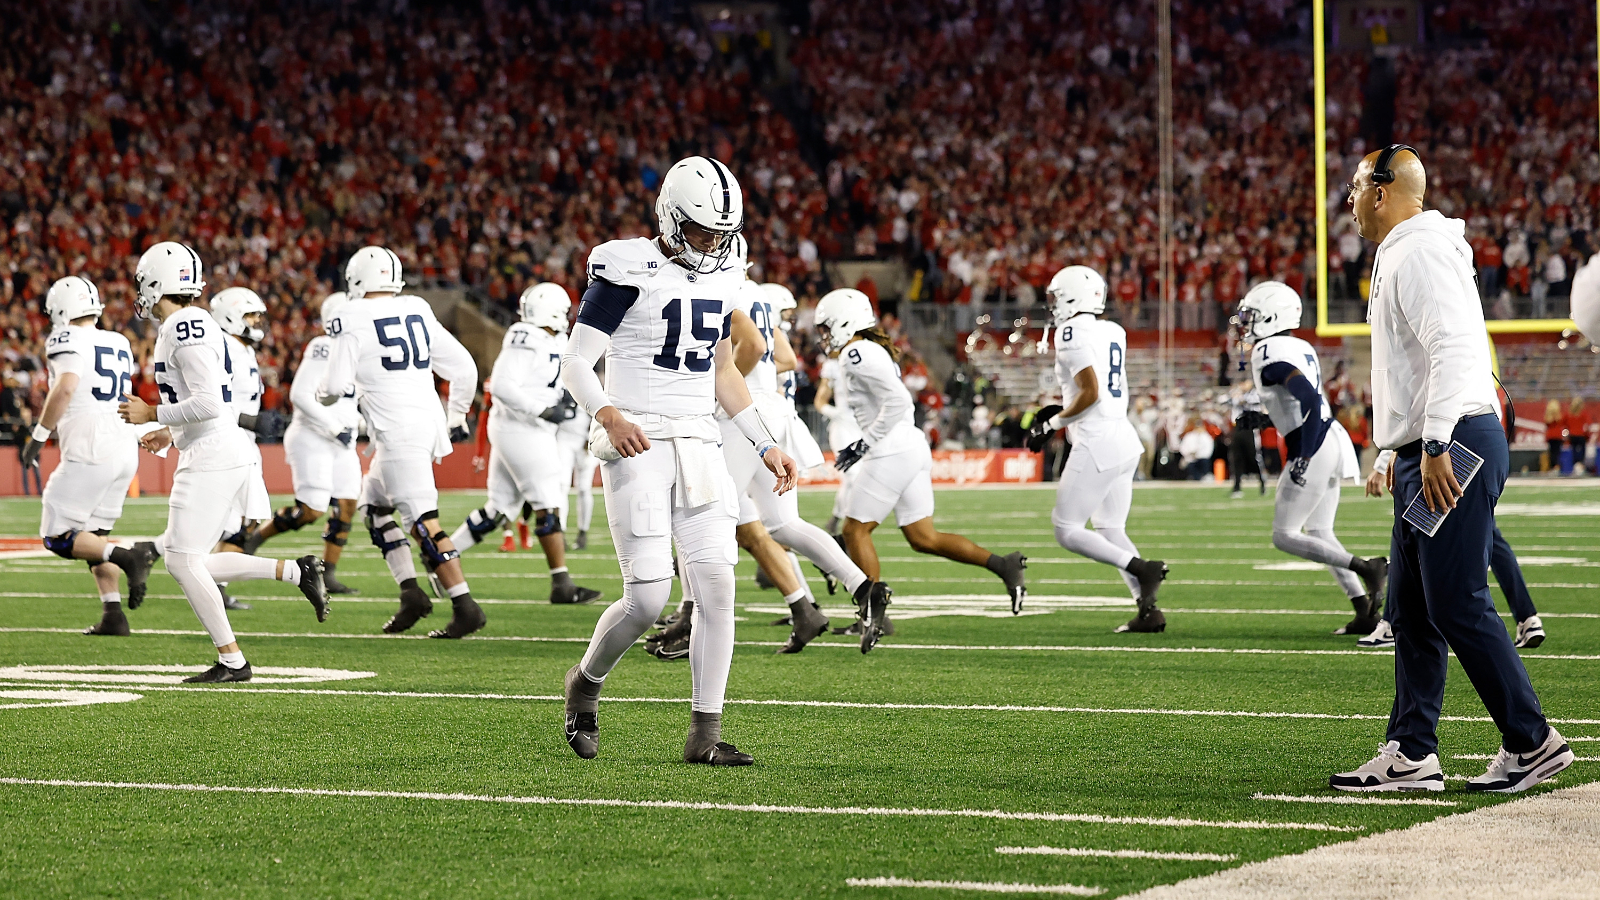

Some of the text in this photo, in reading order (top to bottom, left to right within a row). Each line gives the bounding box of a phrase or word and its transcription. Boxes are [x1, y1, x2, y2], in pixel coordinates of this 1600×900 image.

[175, 319, 206, 341] 95
[511, 329, 530, 345] 77
[653, 298, 724, 373] 15
[1062, 326, 1073, 342] 8
[373, 314, 431, 372] 50
[1257, 343, 1270, 361] 7
[848, 348, 862, 365] 9
[91, 344, 132, 403] 52
[1107, 341, 1123, 398] 8
